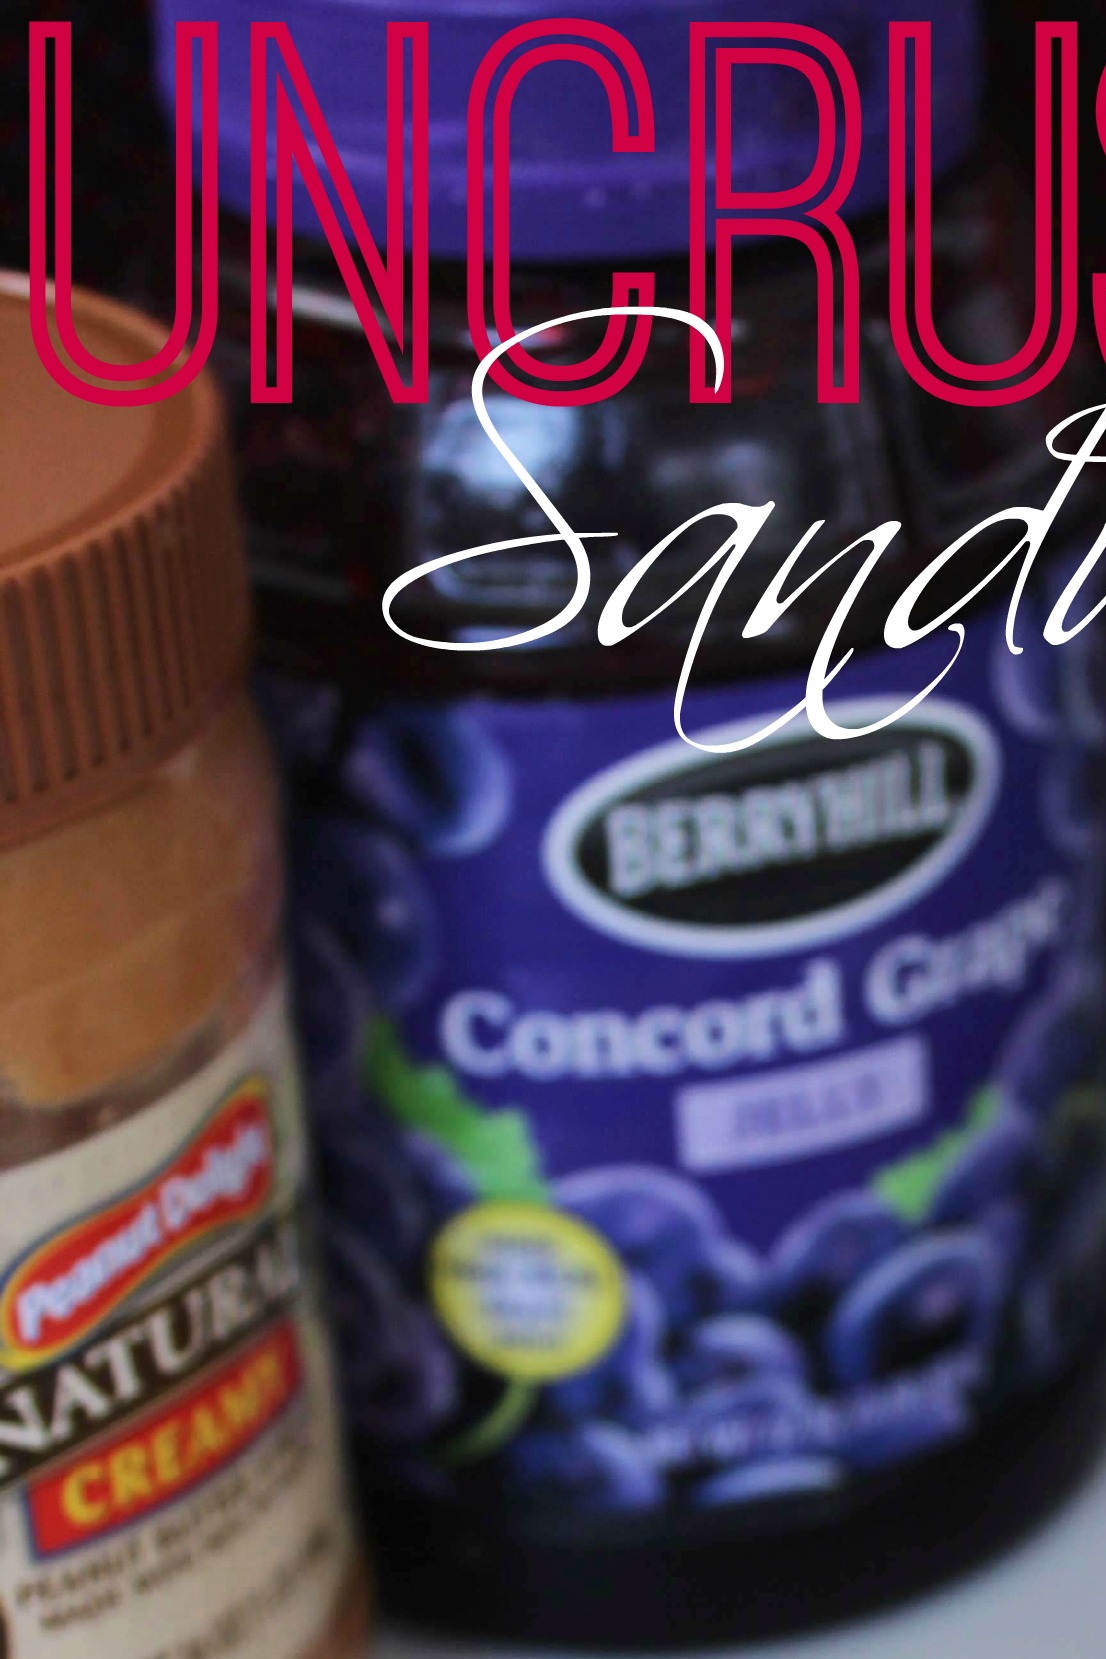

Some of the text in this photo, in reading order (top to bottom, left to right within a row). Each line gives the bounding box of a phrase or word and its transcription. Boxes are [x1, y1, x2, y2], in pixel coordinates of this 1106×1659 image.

[606, 738, 952, 899] BERRYHILL
[440, 959, 843, 1080] Concord
[16, 1200, 163, 1344] Peanut
[61, 1345, 283, 1525] CREAMY
